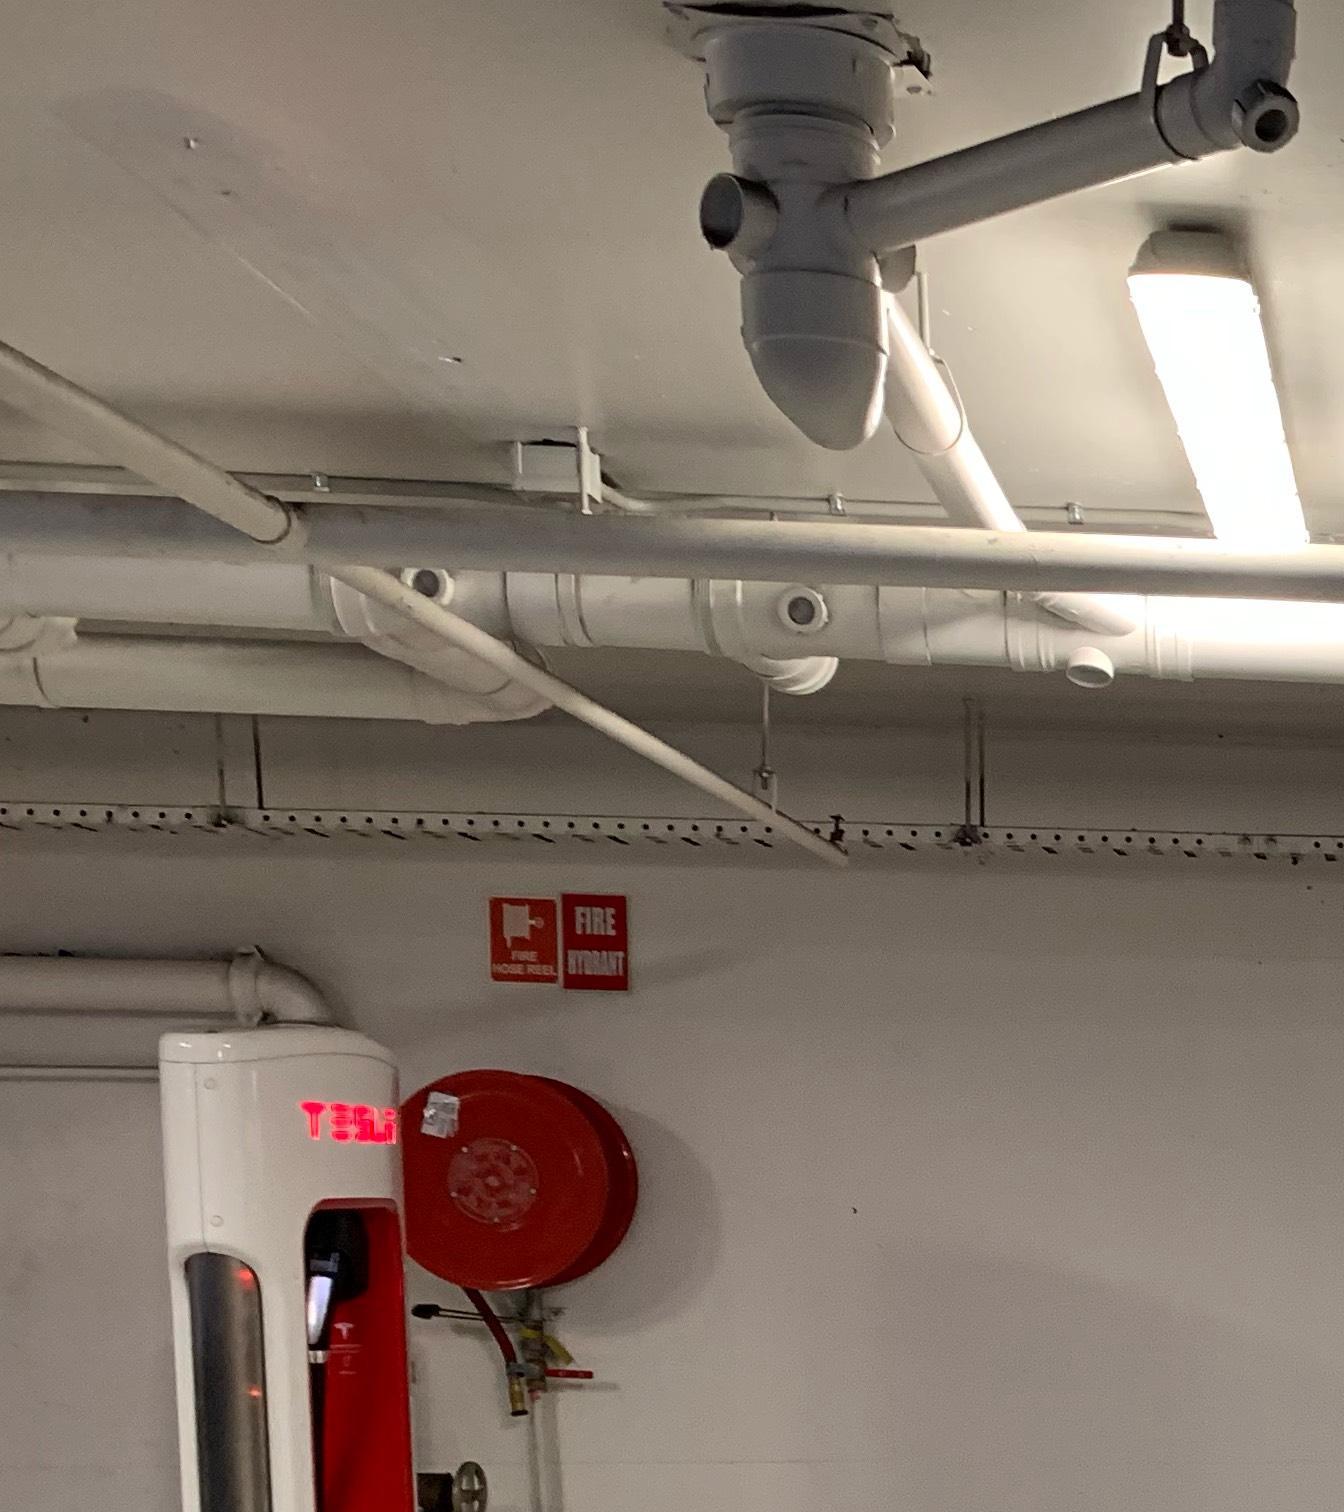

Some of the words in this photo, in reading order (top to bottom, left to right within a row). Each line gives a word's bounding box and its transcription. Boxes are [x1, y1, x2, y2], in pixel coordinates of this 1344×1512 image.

[574, 906, 616, 936] FIRE
[511, 950, 538, 961] FIRE
[567, 949, 624, 976] HYDRANT
[493, 963, 524, 975] HOSE
[525, 964, 557, 976] REEL
[300, 1101, 397, 1144] TESLA
